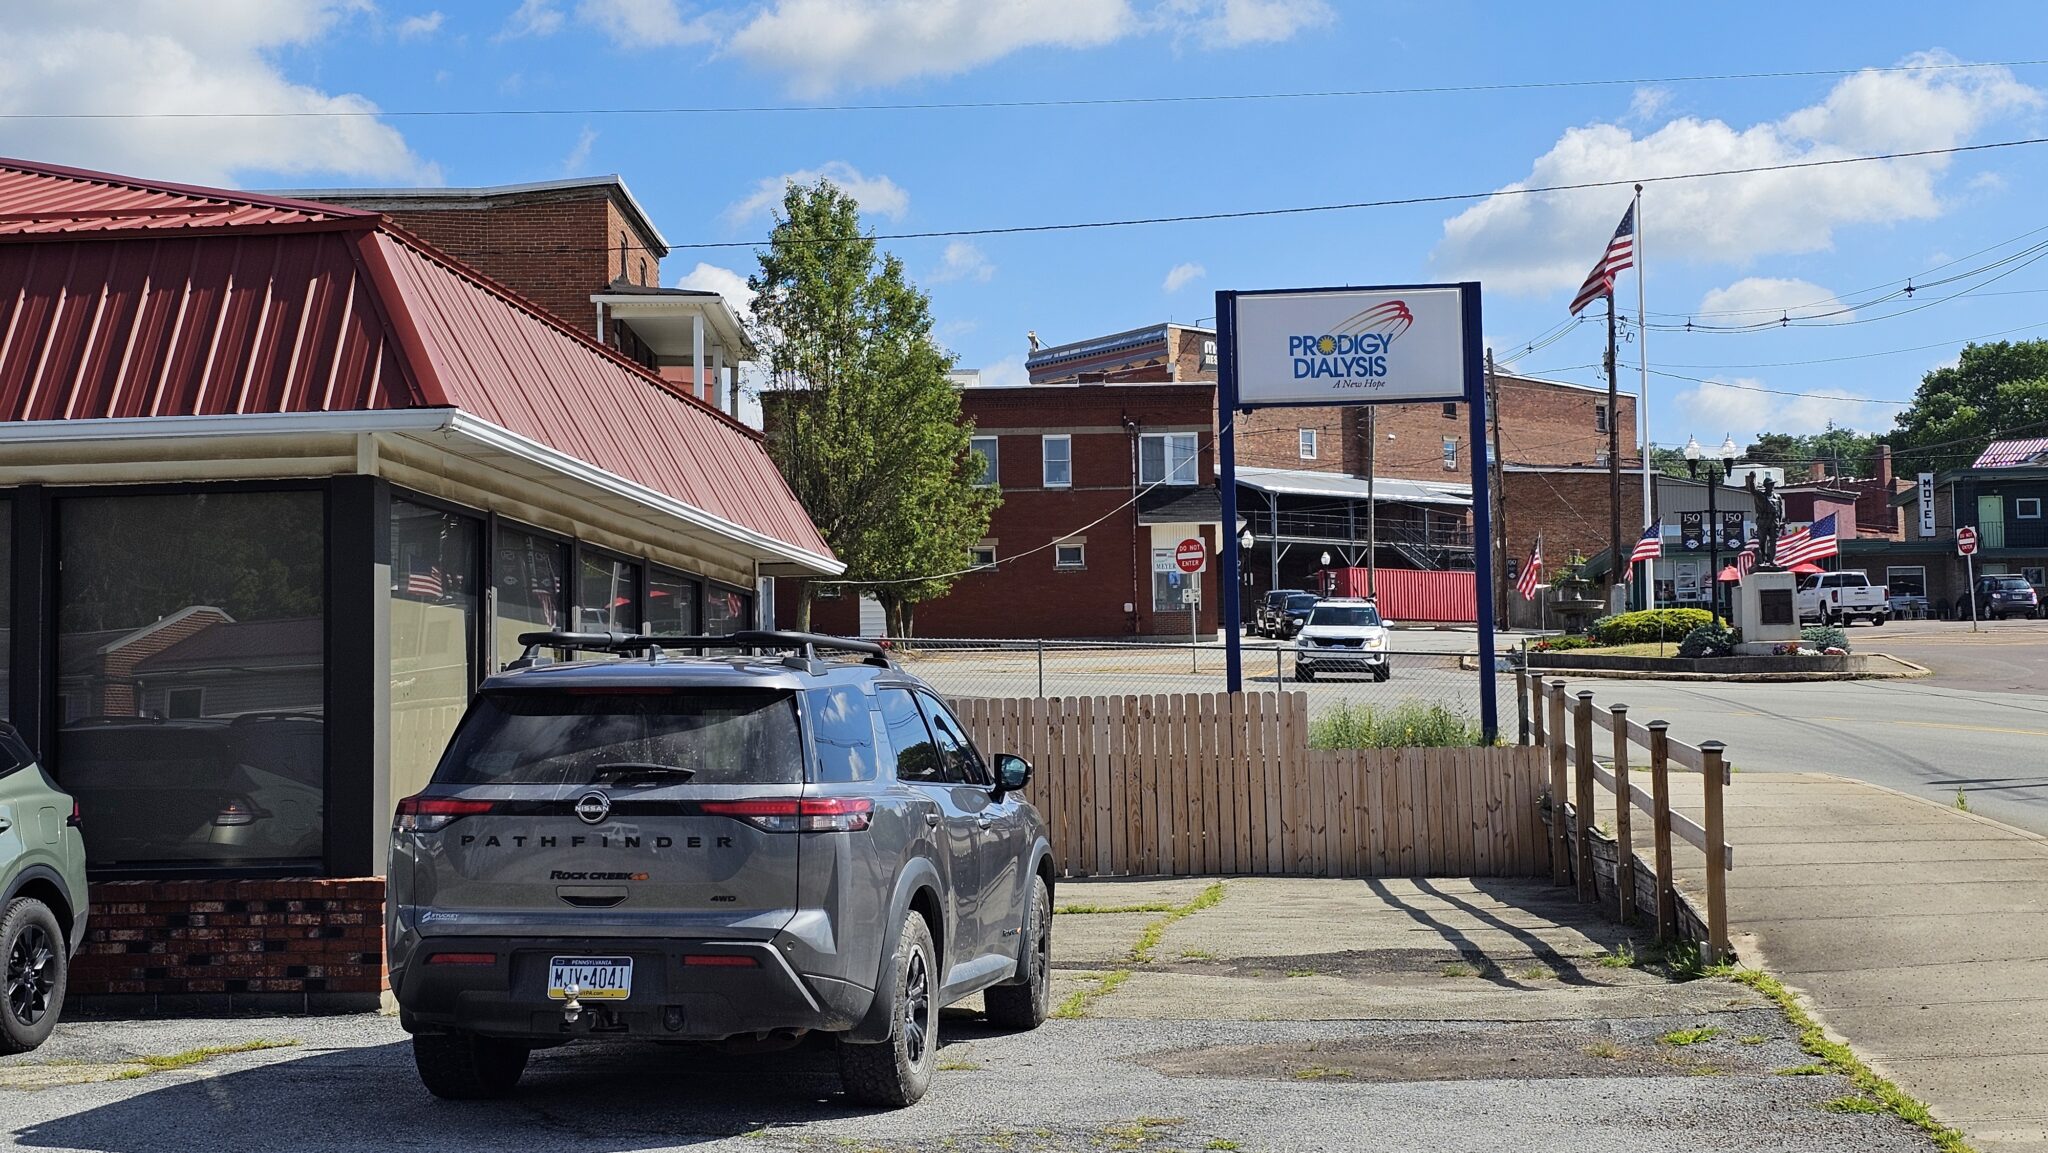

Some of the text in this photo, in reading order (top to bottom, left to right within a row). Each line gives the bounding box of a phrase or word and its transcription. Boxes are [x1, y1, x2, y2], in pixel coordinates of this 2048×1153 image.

[1289, 333, 1393, 356] PRODIGY
[1294, 355, 1387, 379] DIALYSIS
[1332, 378, 1386, 390] A New Hope
[1923, 479, 1932, 529] MOTEL
[1683, 513, 1700, 524] 150
[1725, 512, 1742, 523] 150
[574, 804, 610, 812] NISSAN
[460, 835, 733, 848] PATHFINDER
[550, 870, 633, 880] ROCK CREEK
